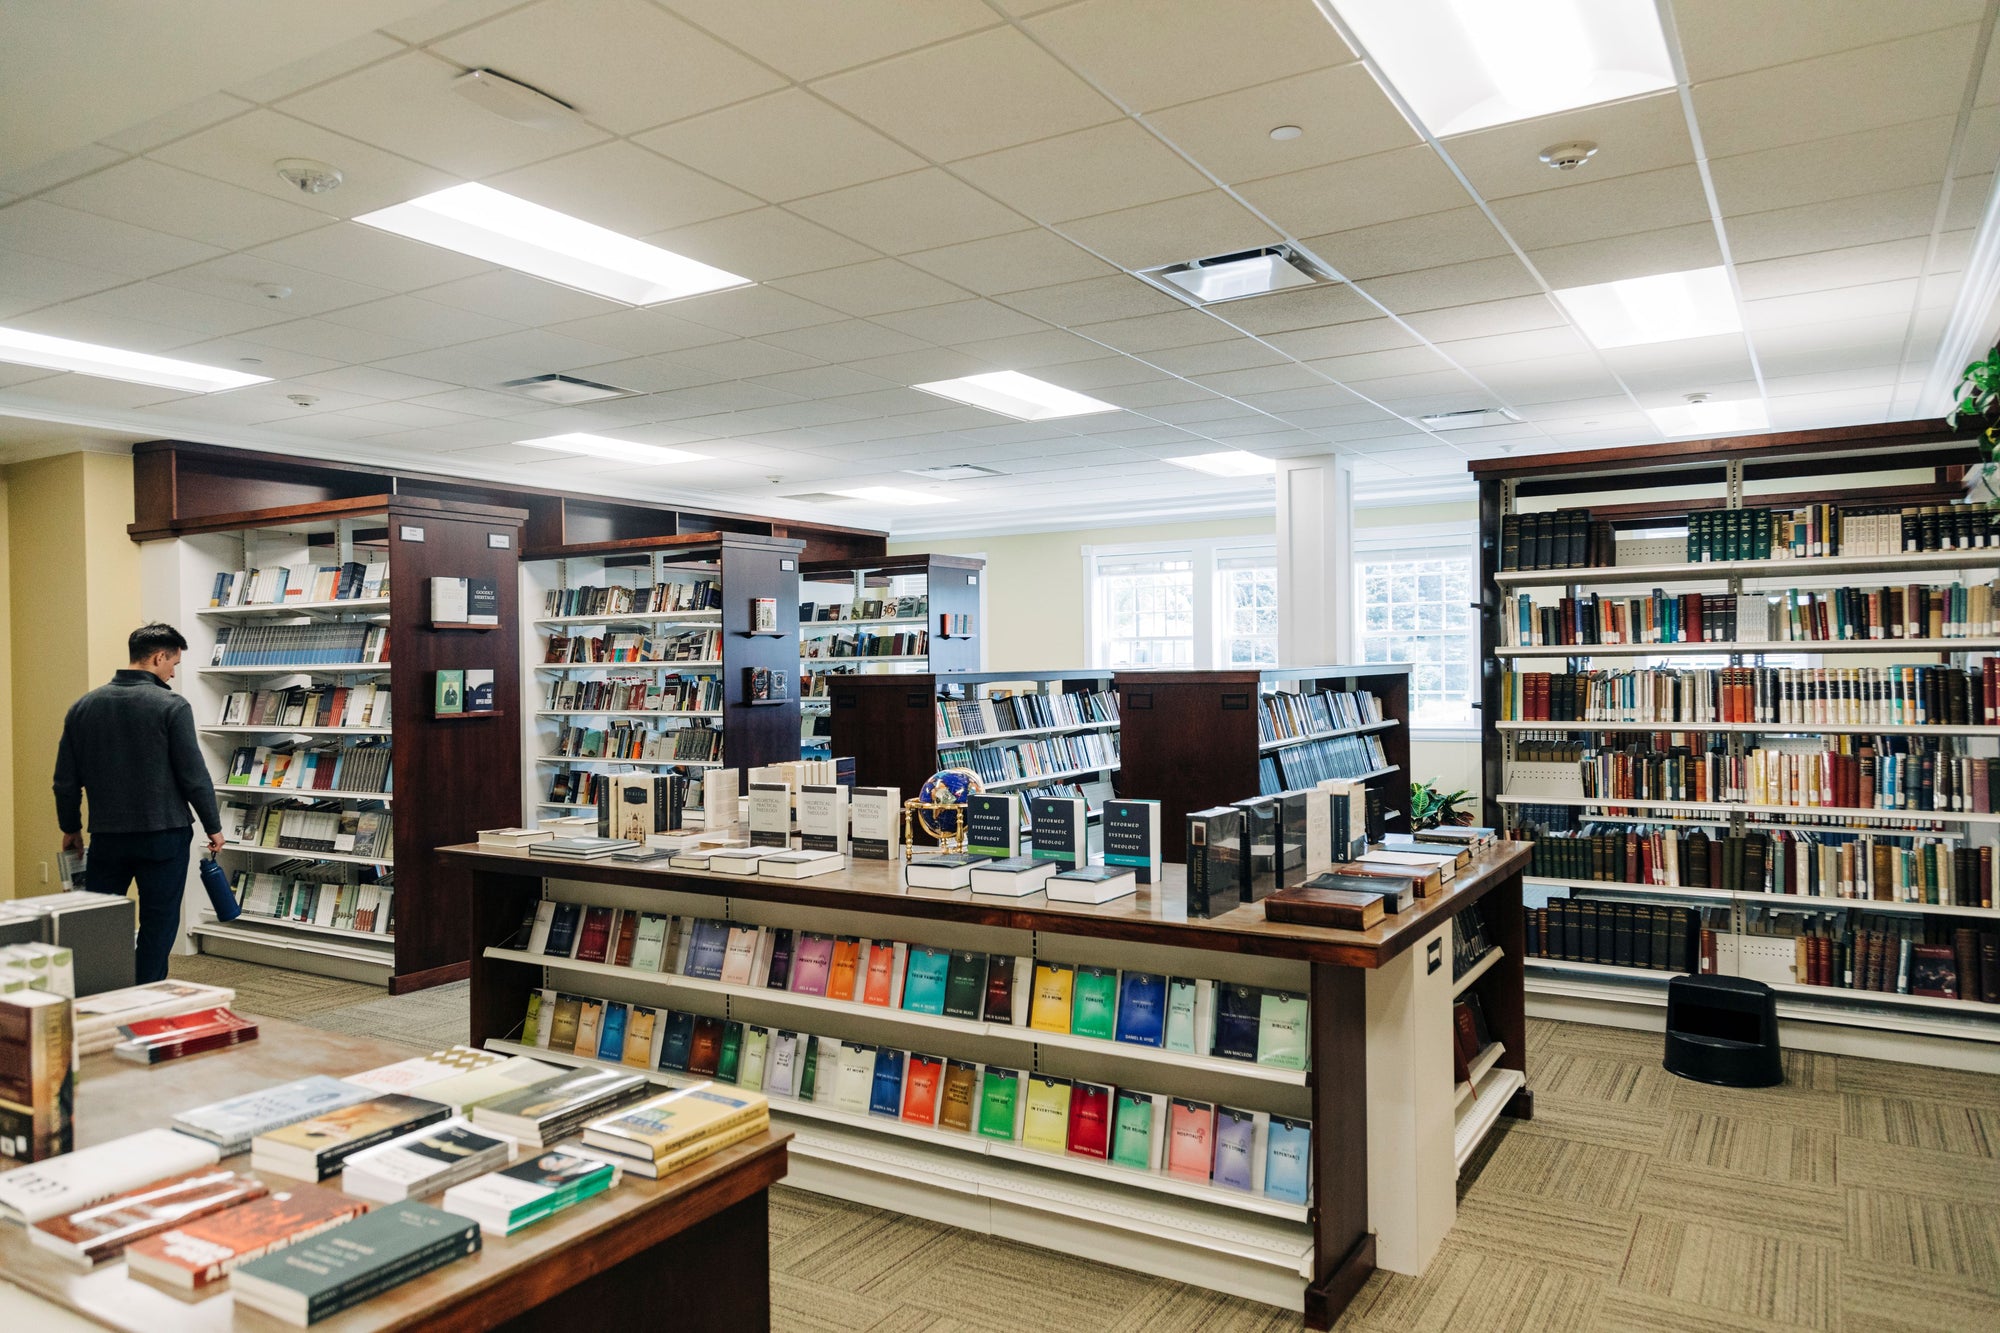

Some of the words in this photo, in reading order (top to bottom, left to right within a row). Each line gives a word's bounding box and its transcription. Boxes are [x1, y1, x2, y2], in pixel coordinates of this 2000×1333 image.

[881, 602, 897, 618] 365
[1036, 1107, 1062, 1116] EVERYTHING
[1274, 1150, 1300, 1160] REPENTANCE
